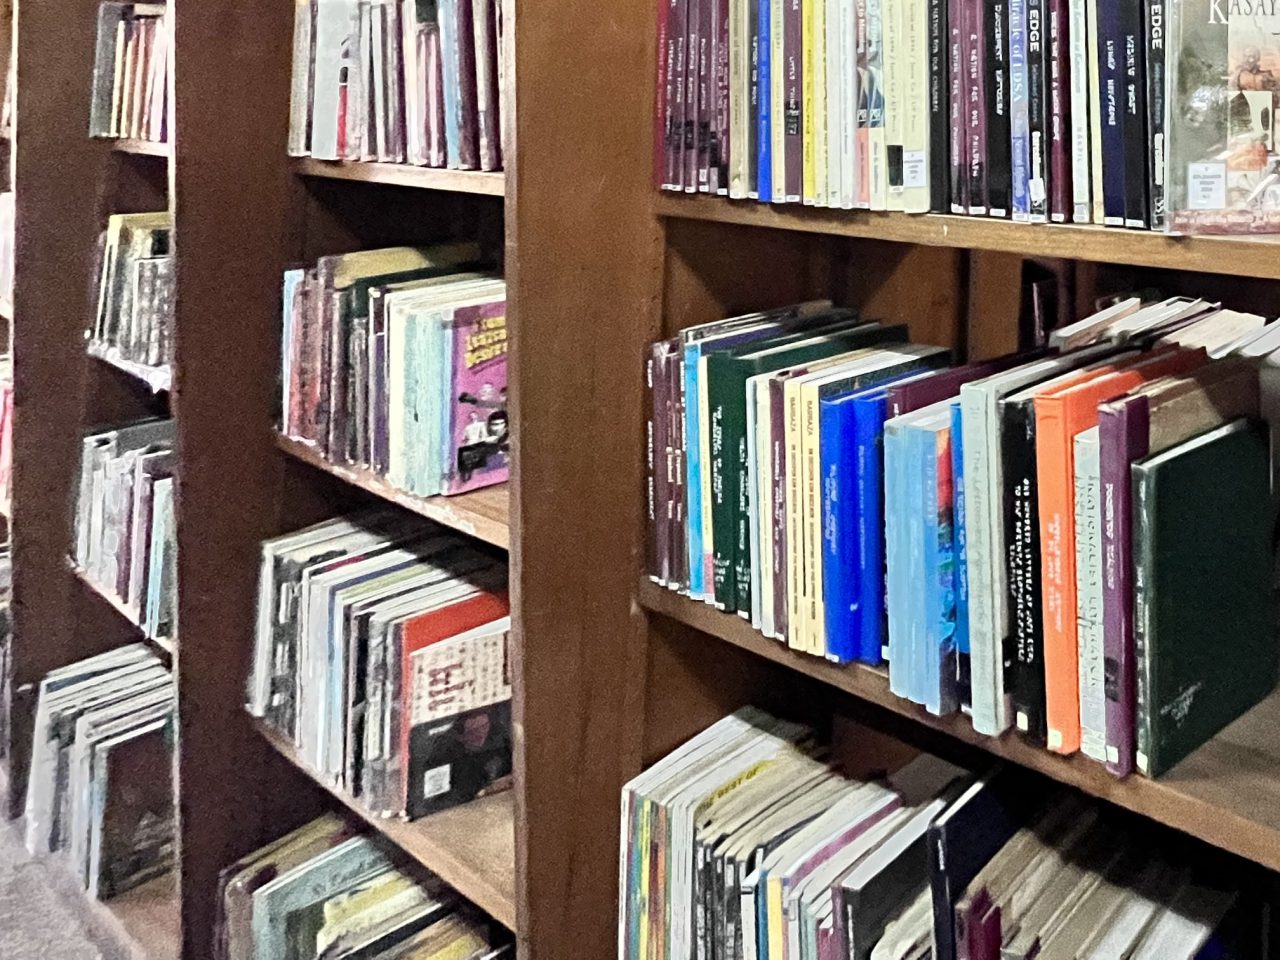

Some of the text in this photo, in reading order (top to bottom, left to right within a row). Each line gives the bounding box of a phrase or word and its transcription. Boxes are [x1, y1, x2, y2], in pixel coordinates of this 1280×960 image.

[1029, 9, 1039, 52] EDGE
[1151, 4, 1162, 50] EDGE
[970, 49, 978, 78] NATION
[1012, 45, 1023, 58] of
[1013, 63, 1022, 102] EDSA
[1015, 486, 1021, 496] TO
[1026, 595, 1032, 608] OF
